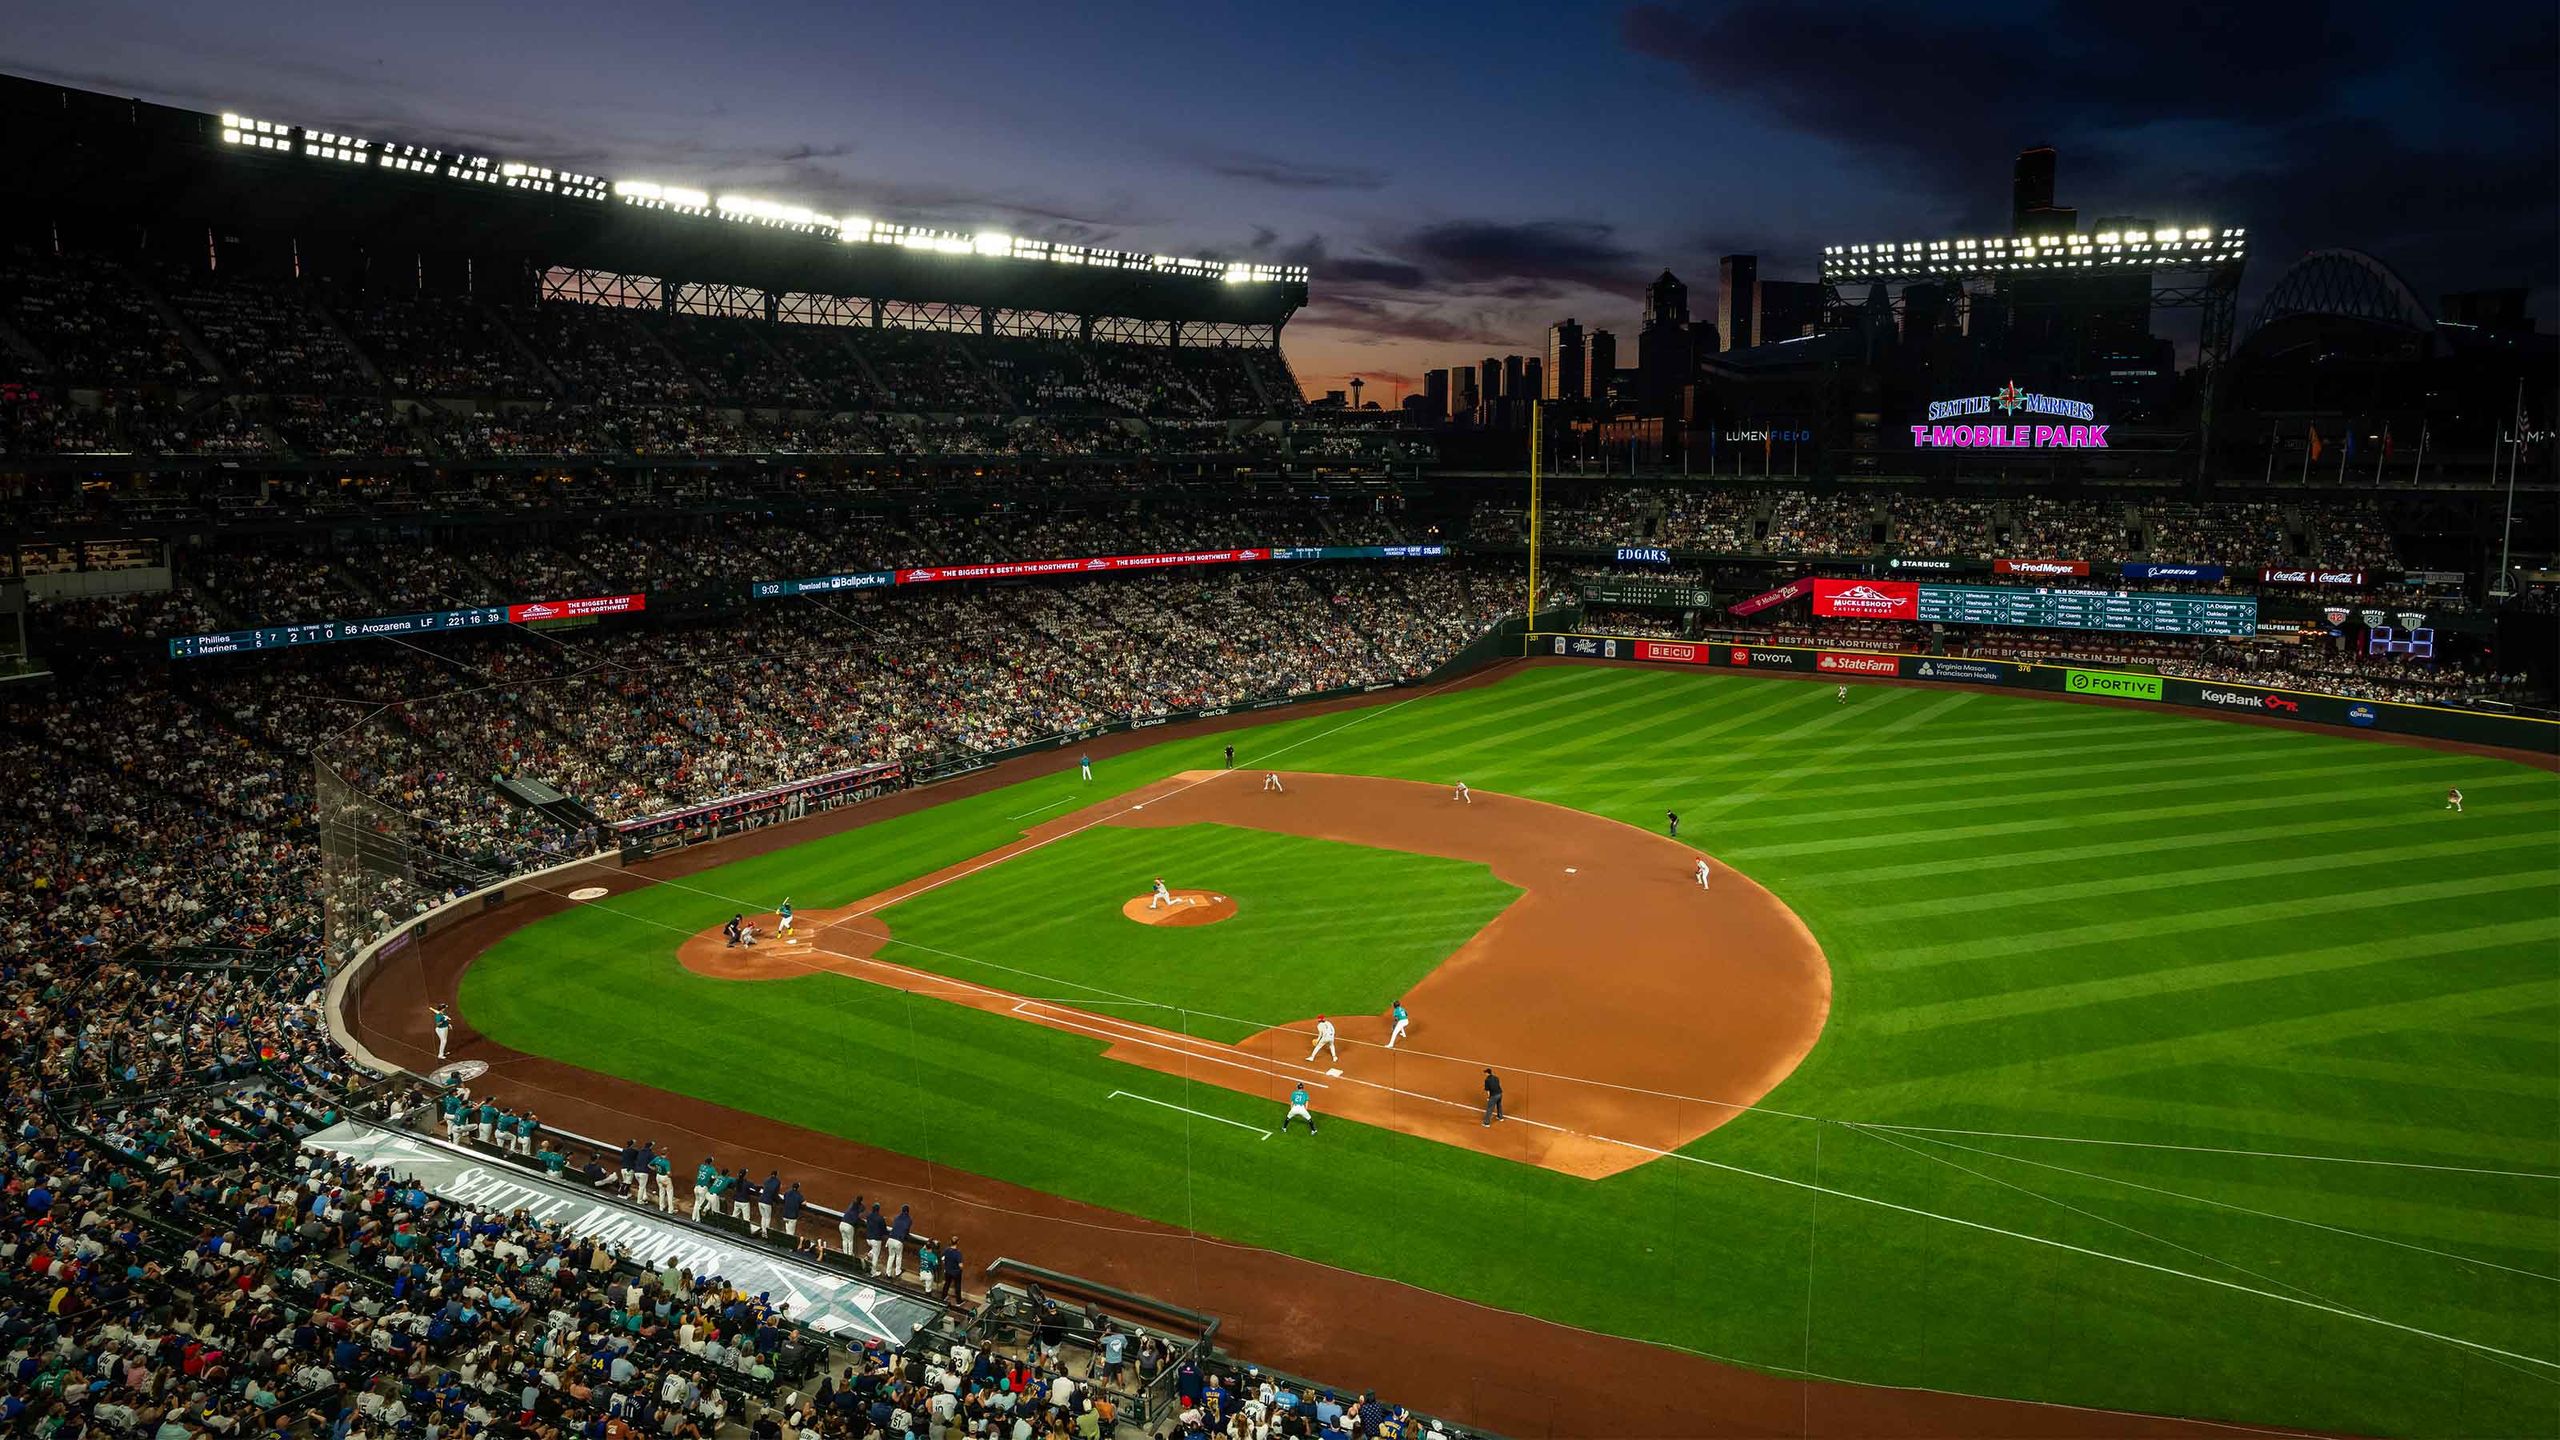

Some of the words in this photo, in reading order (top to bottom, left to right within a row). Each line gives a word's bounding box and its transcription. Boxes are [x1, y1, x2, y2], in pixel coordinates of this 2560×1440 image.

[1928, 396, 1991, 421] SEATTLE
[2025, 393, 2094, 421] MARINERS
[1726, 431, 1768, 441] LUMEN
[1911, 425, 2031, 447] T-MOBILE
[2034, 425, 2110, 448] PARK
[1197, 553, 1231, 561] NORTHWEST
[958, 568, 988, 576] BIGGEST
[996, 566, 1014, 574] BEST
[1039, 562, 1079, 571] NORTHWEST
[1902, 560, 1950, 569] STARBUCKS
[799, 581, 821, 591] Download
[841, 574, 874, 589] Ballpark
[761, 585, 779, 595] 9:02
[581, 599, 607, 608] BIGGEST
[615, 597, 630, 605] BEST
[1833, 599, 1892, 608] MUCKLESHOOT
[590, 604, 629, 612] NORTHWEST
[2331, 613, 2342, 622] 42
[2368, 616, 2378, 624] 24
[2397, 612, 2426, 620] MARTINEZ
[2407, 619, 2416, 627] 11
[198, 635, 231, 645] Phillies
[290, 633, 298, 643] 2
[309, 632, 315, 640] 1
[326, 630, 333, 638] 0
[345, 625, 357, 635] 56
[361, 621, 411, 633] Arozarena
[421, 618, 433, 628] LF
[446, 617, 465, 627] .221
[470, 615, 481, 625] 16
[487, 613, 499, 623] 39
[199, 644, 238, 655] Mariners
[256, 640, 262, 648] 5
[1778, 636, 1802, 645] BEST
[1816, 638, 1835, 646] THE
[1838, 640, 1901, 650] NORTHWEST
[1752, 653, 1792, 663] TOYOTA
[1979, 647, 1998, 656] THE
[2105, 655, 2127, 664] THE
[1936, 663, 1962, 672] Virginia
[1964, 664, 1987, 672] Mason
[2018, 665, 2031, 673] 376
[1936, 670, 1973, 678] Franciscan
[1974, 671, 1997, 680] Health
[2092, 678, 2156, 694] FORTIVE
[2202, 690, 2263, 708] KeyBank
[1199, 710, 1215, 718] Great
[1215, 708, 1229, 717] Clips
[1140, 718, 1166, 727] LEXUS
[559, 1205, 733, 1277] MARINERS
[591, 1358, 604, 1370] 24
[626, 1405, 634, 1417] 11
